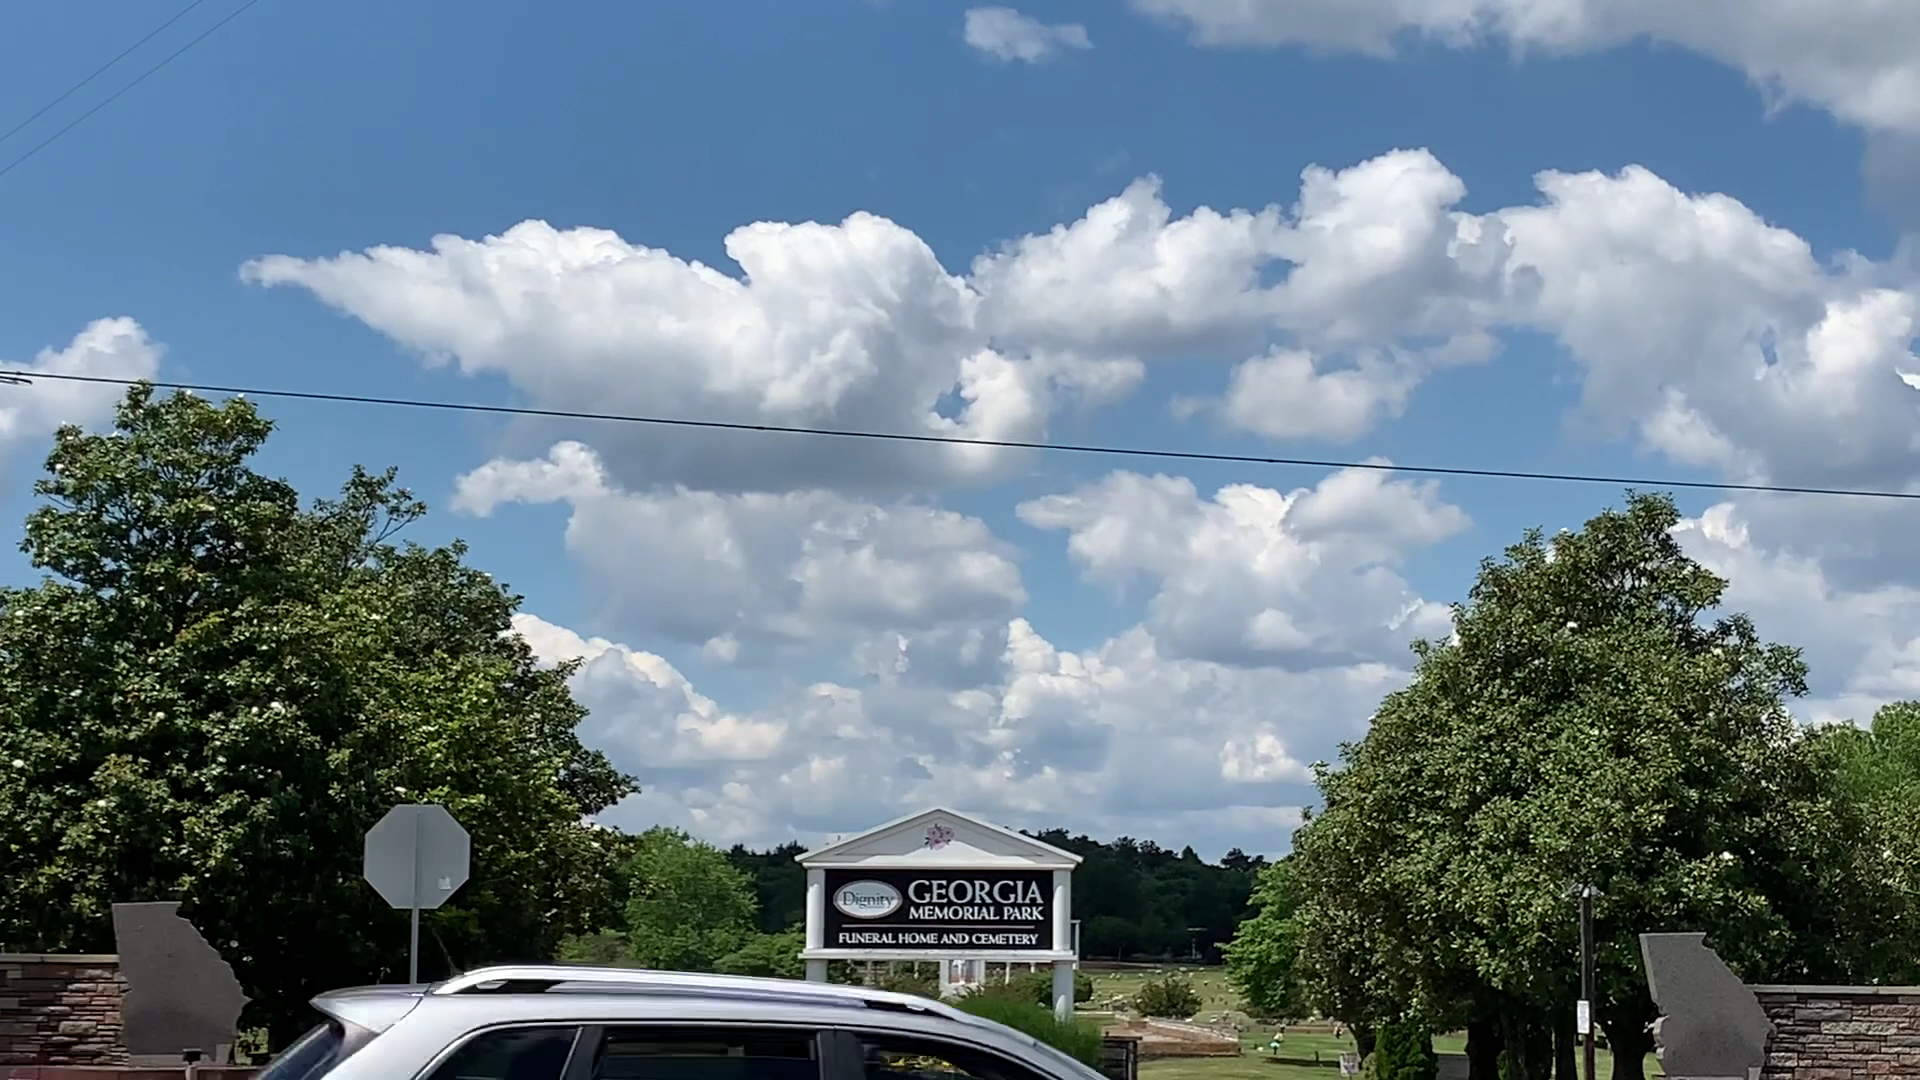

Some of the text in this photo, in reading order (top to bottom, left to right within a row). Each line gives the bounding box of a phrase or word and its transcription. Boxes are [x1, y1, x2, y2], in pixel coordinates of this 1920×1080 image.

[842, 891, 893, 909] Dignity
[908, 880, 1044, 904] GEORGIA
[908, 906, 1044, 921] MEMORIAL PARK
[838, 932, 1039, 946] FUNERAL HOME AND CEMETERY
